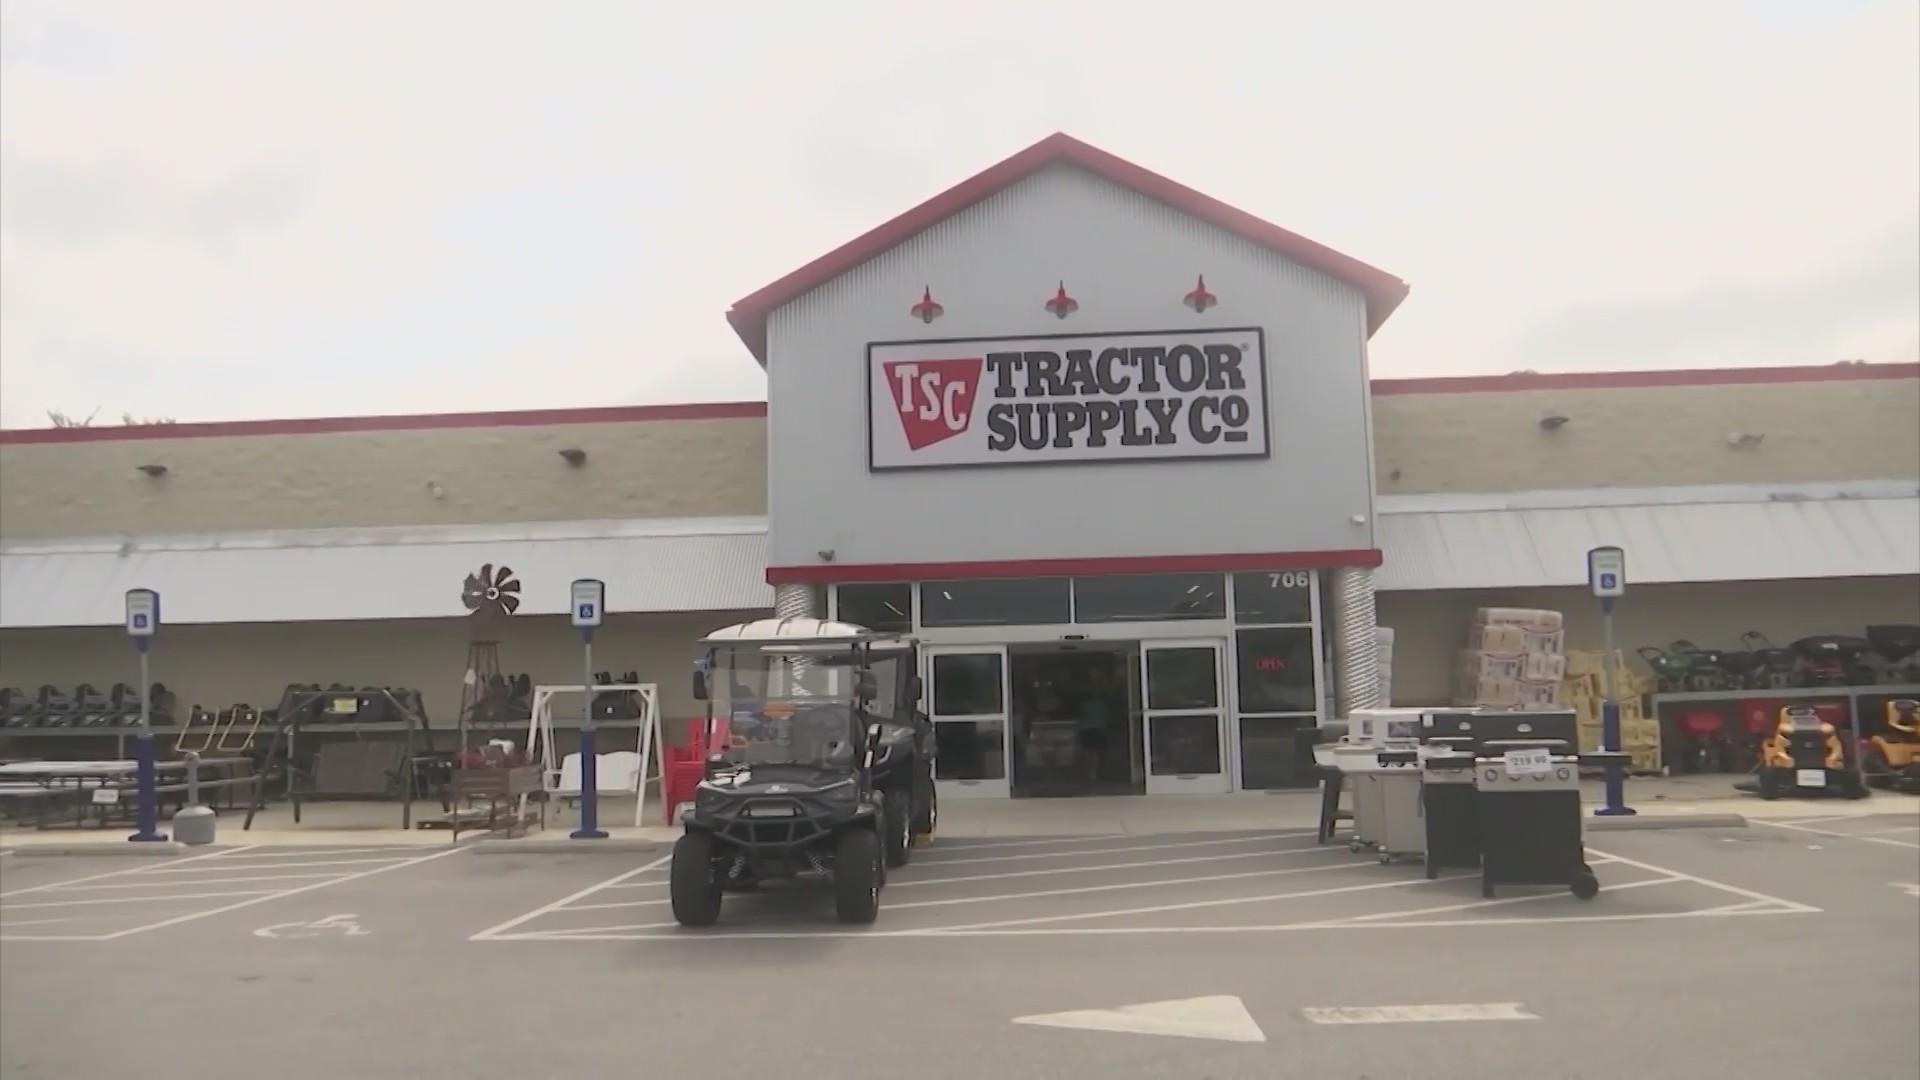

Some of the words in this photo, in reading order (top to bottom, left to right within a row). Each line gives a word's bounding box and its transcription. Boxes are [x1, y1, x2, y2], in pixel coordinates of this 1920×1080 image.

[895, 364, 968, 431] TSC
[987, 345, 1246, 398] TRACTOR
[987, 398, 1182, 452] SUPPLY
[1268, 571, 1309, 588] 706
